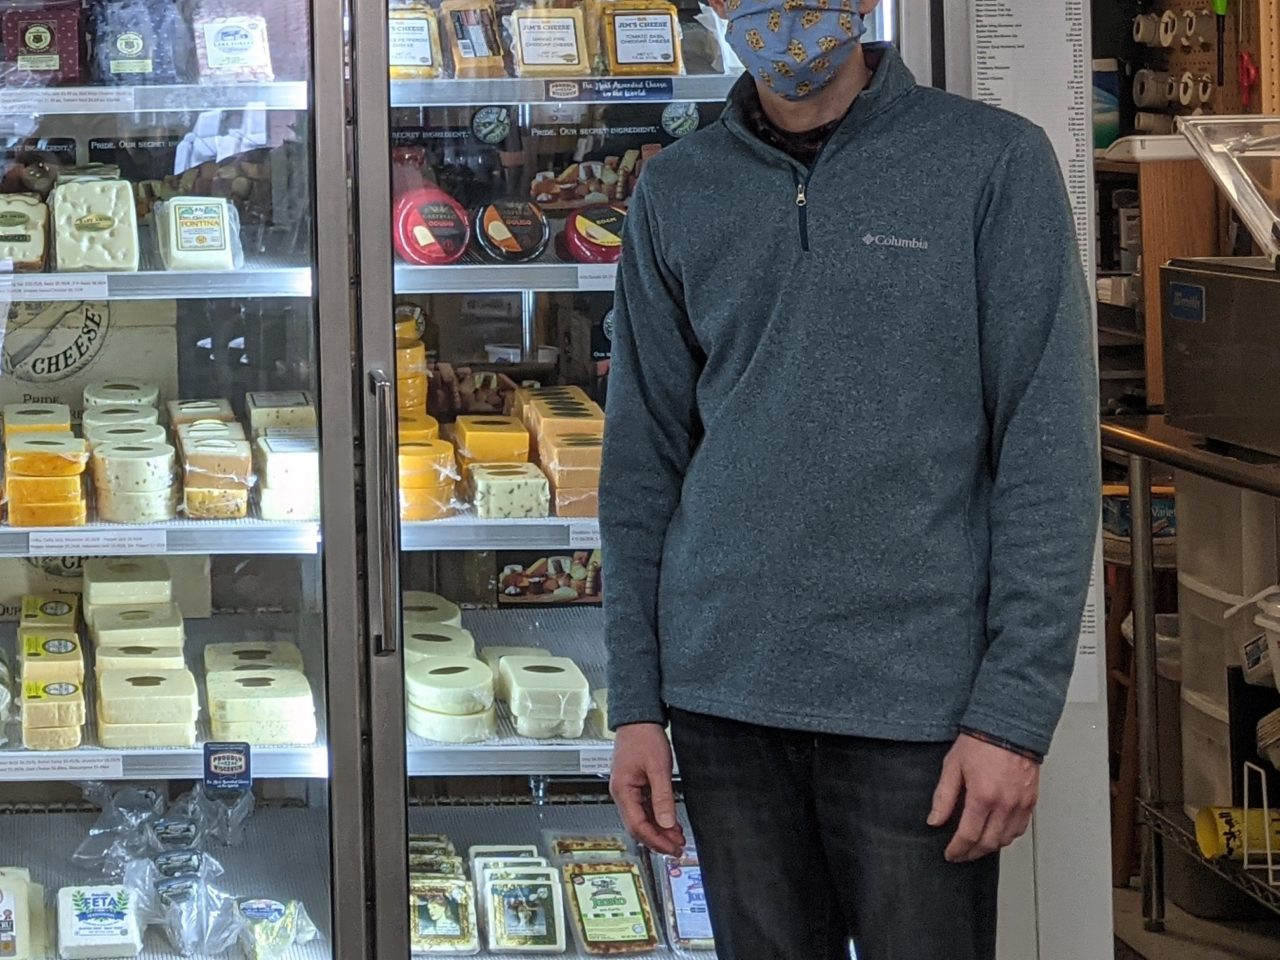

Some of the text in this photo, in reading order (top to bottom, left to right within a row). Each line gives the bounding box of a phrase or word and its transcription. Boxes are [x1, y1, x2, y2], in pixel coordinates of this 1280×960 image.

[180, 220, 220, 228] FONTINA
[874, 234, 929, 249] Columbia
[30, 307, 102, 375] CHEESE
[84, 896, 118, 907] FETA
